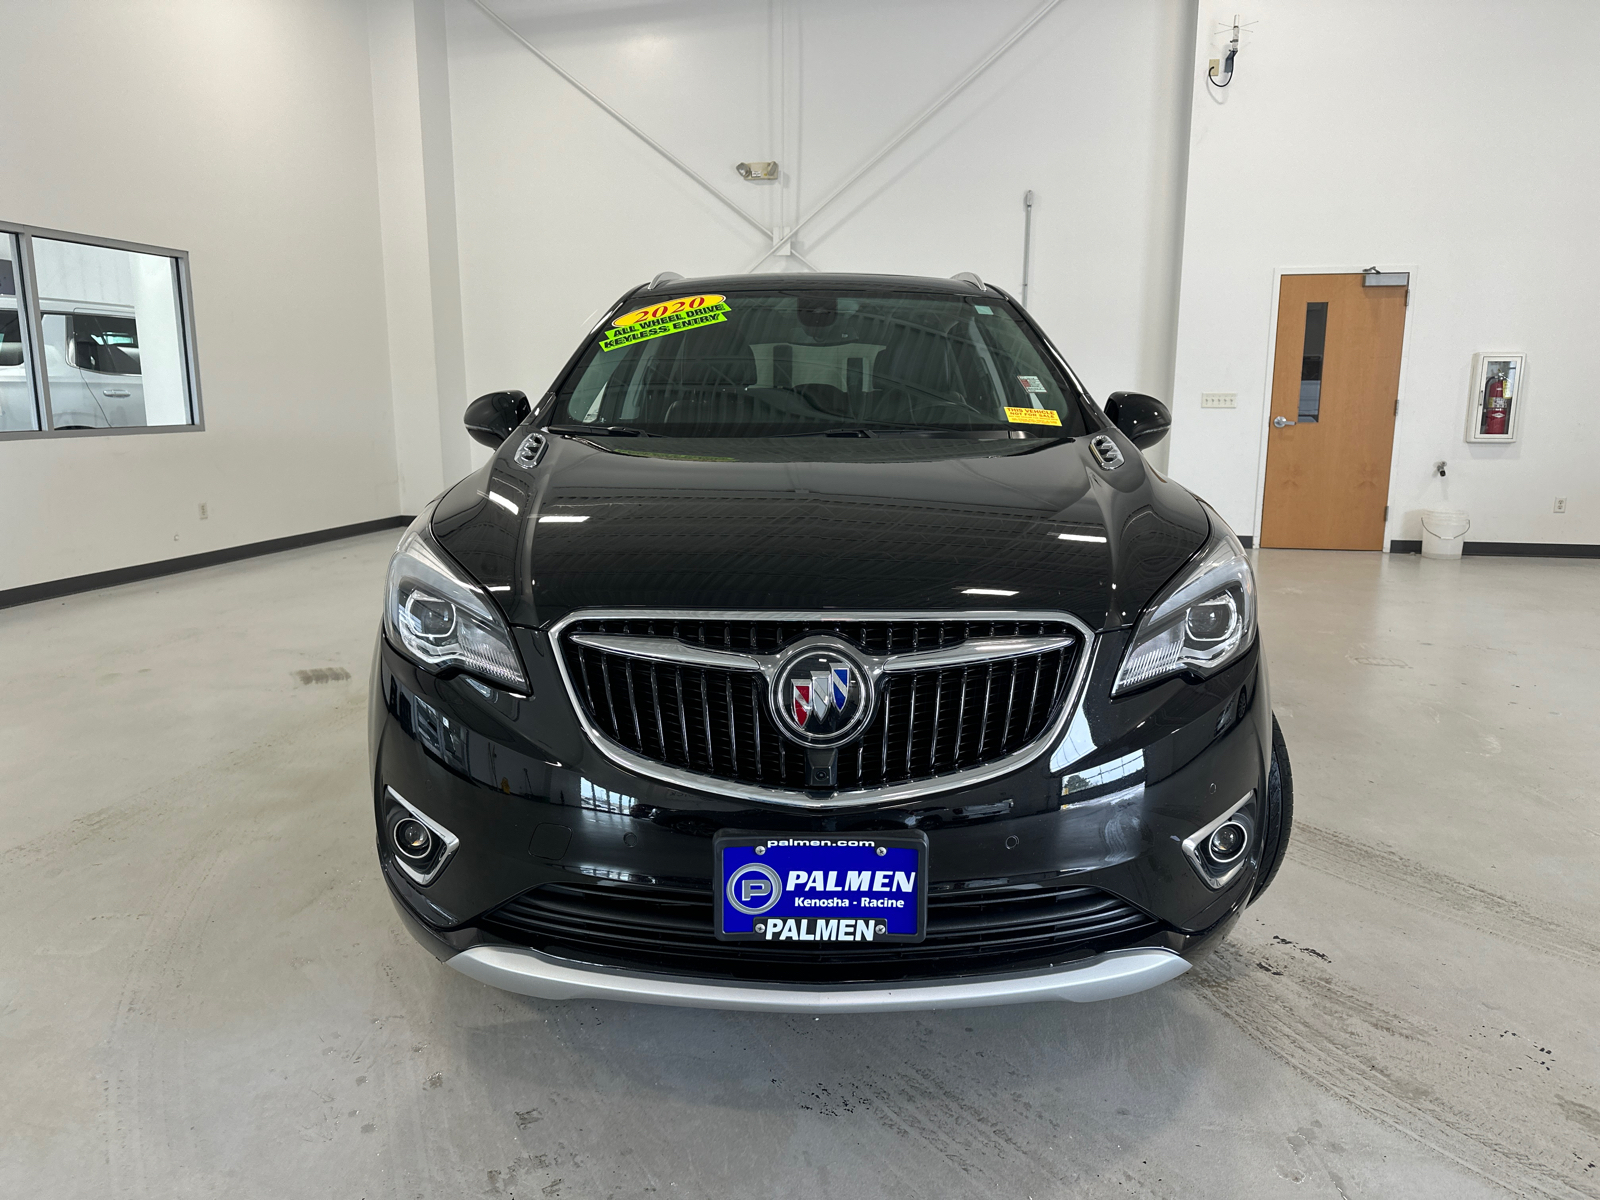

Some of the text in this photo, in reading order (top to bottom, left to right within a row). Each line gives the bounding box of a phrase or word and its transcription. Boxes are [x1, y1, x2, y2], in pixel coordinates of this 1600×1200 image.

[614, 304, 725, 337] ALL WHEEL DRIVE
[635, 297, 705, 324] 2020
[604, 314, 720, 348] KEYLESS ENTRY
[767, 839, 875, 848] palmen.com
[741, 879, 772, 901] P
[786, 870, 916, 893] PALMEN
[794, 897, 849, 907] Kenosha
[861, 897, 905, 908] Racine
[765, 918, 875, 941] PALMEN
